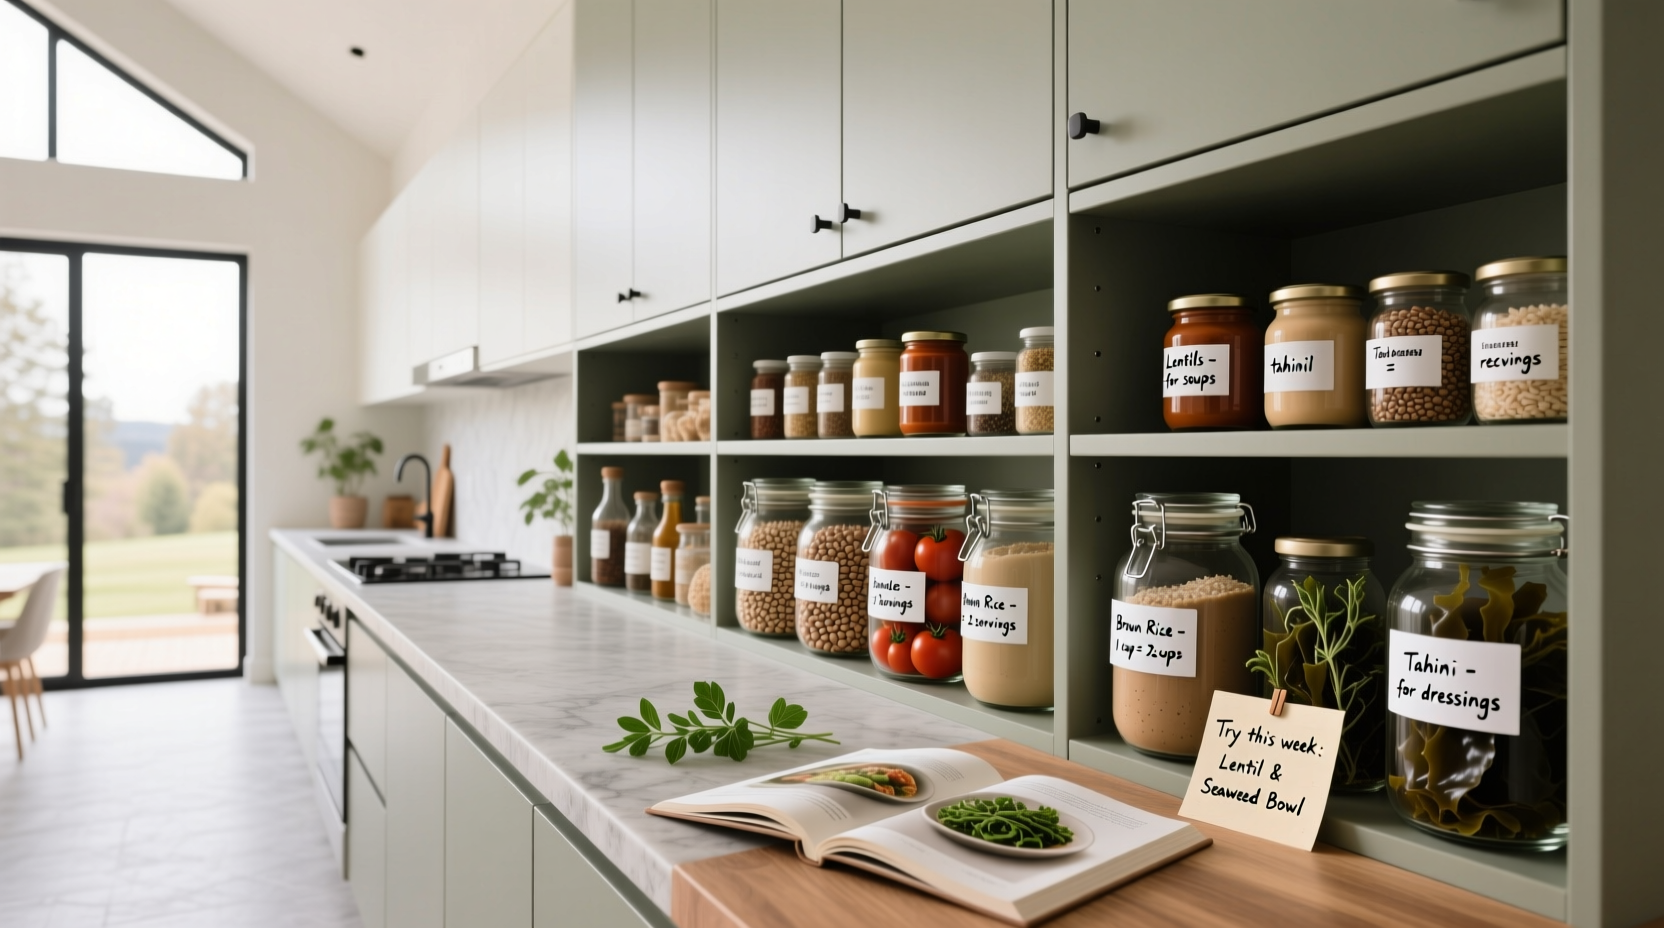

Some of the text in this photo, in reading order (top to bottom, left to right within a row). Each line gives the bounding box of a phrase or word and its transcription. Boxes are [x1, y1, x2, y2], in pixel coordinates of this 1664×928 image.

[1271, 355, 1314, 374] tahinil
[1164, 373, 1216, 391] for soups
[1147, 620, 1172, 637] Rice
[1404, 652, 1456, 676] Tahini
[1397, 678, 1500, 720] for dressings
[1217, 719, 1323, 757] Try this week:
[1219, 754, 1282, 782] Lentil &
[1201, 778, 1305, 816] Seaweed Bowl
